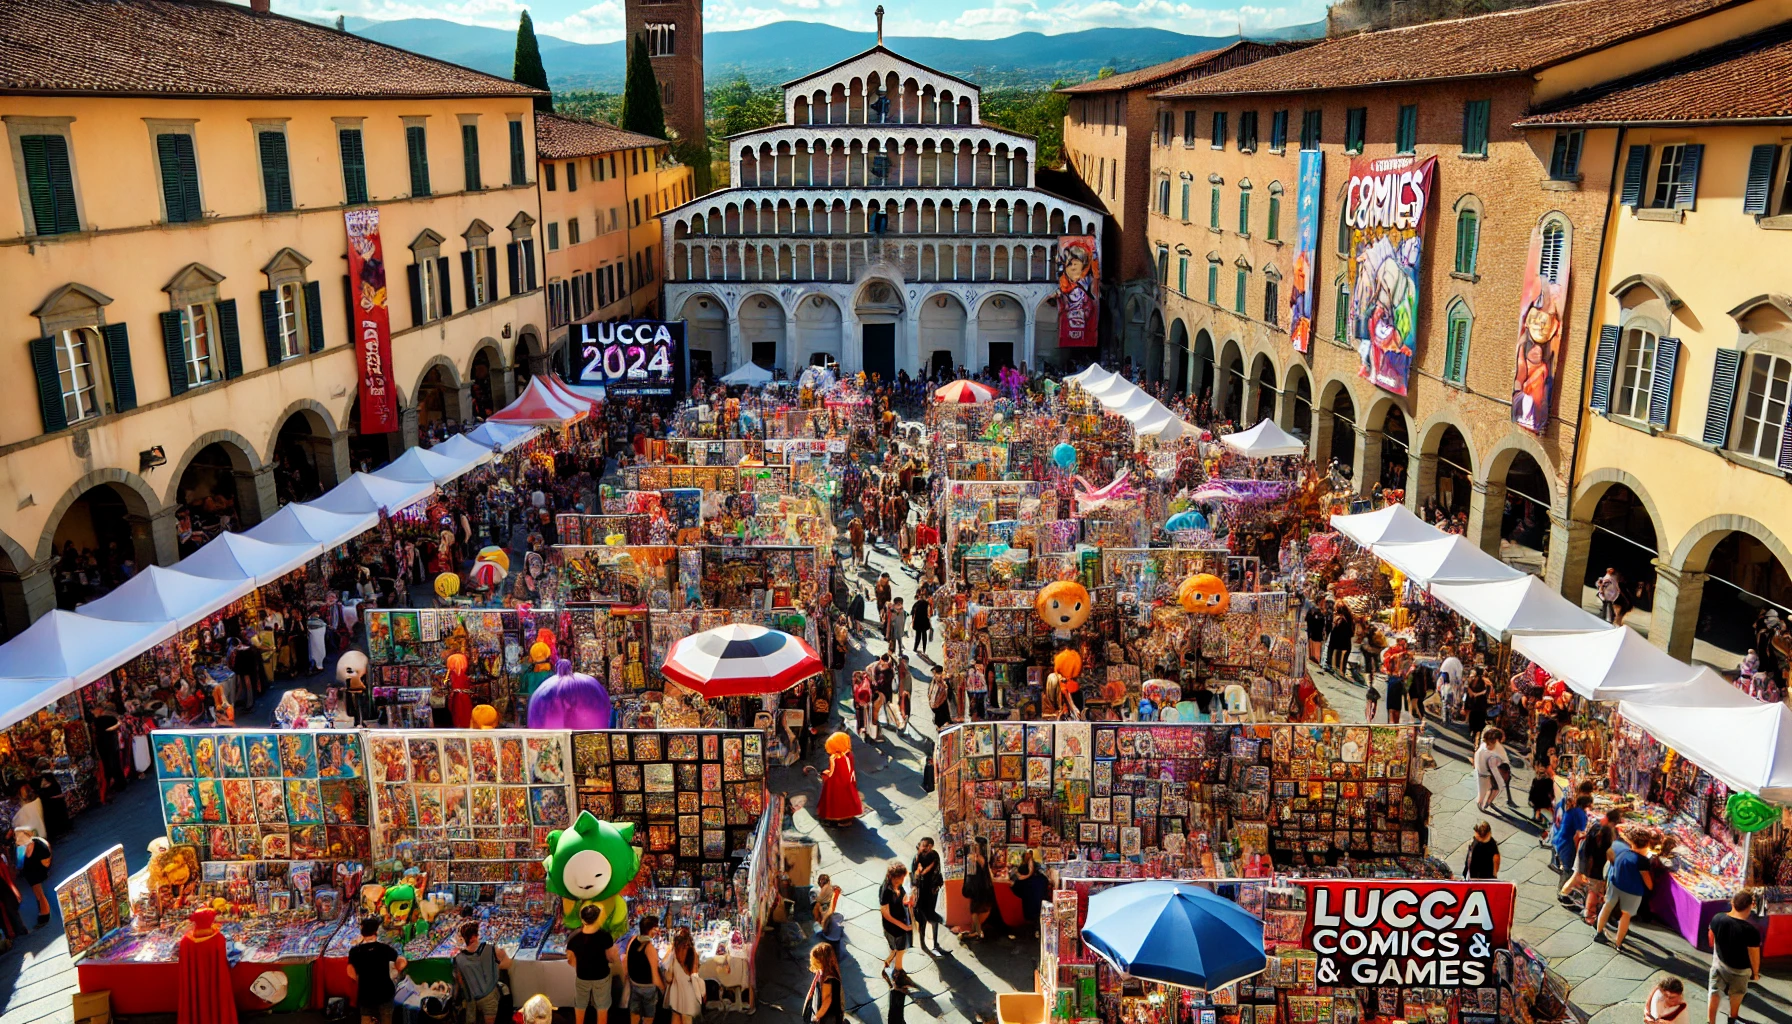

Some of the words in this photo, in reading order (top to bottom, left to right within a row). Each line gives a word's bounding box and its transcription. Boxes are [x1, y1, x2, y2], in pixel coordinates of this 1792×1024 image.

[581, 322, 672, 344] LUCCA
[580, 344, 673, 380] 2024
[1314, 889, 1494, 930] LUCCA
[1313, 929, 1460, 957] COMICS
[1468, 932, 1491, 958] &
[1317, 957, 1341, 983] &
[1351, 958, 1486, 985] GAMES
